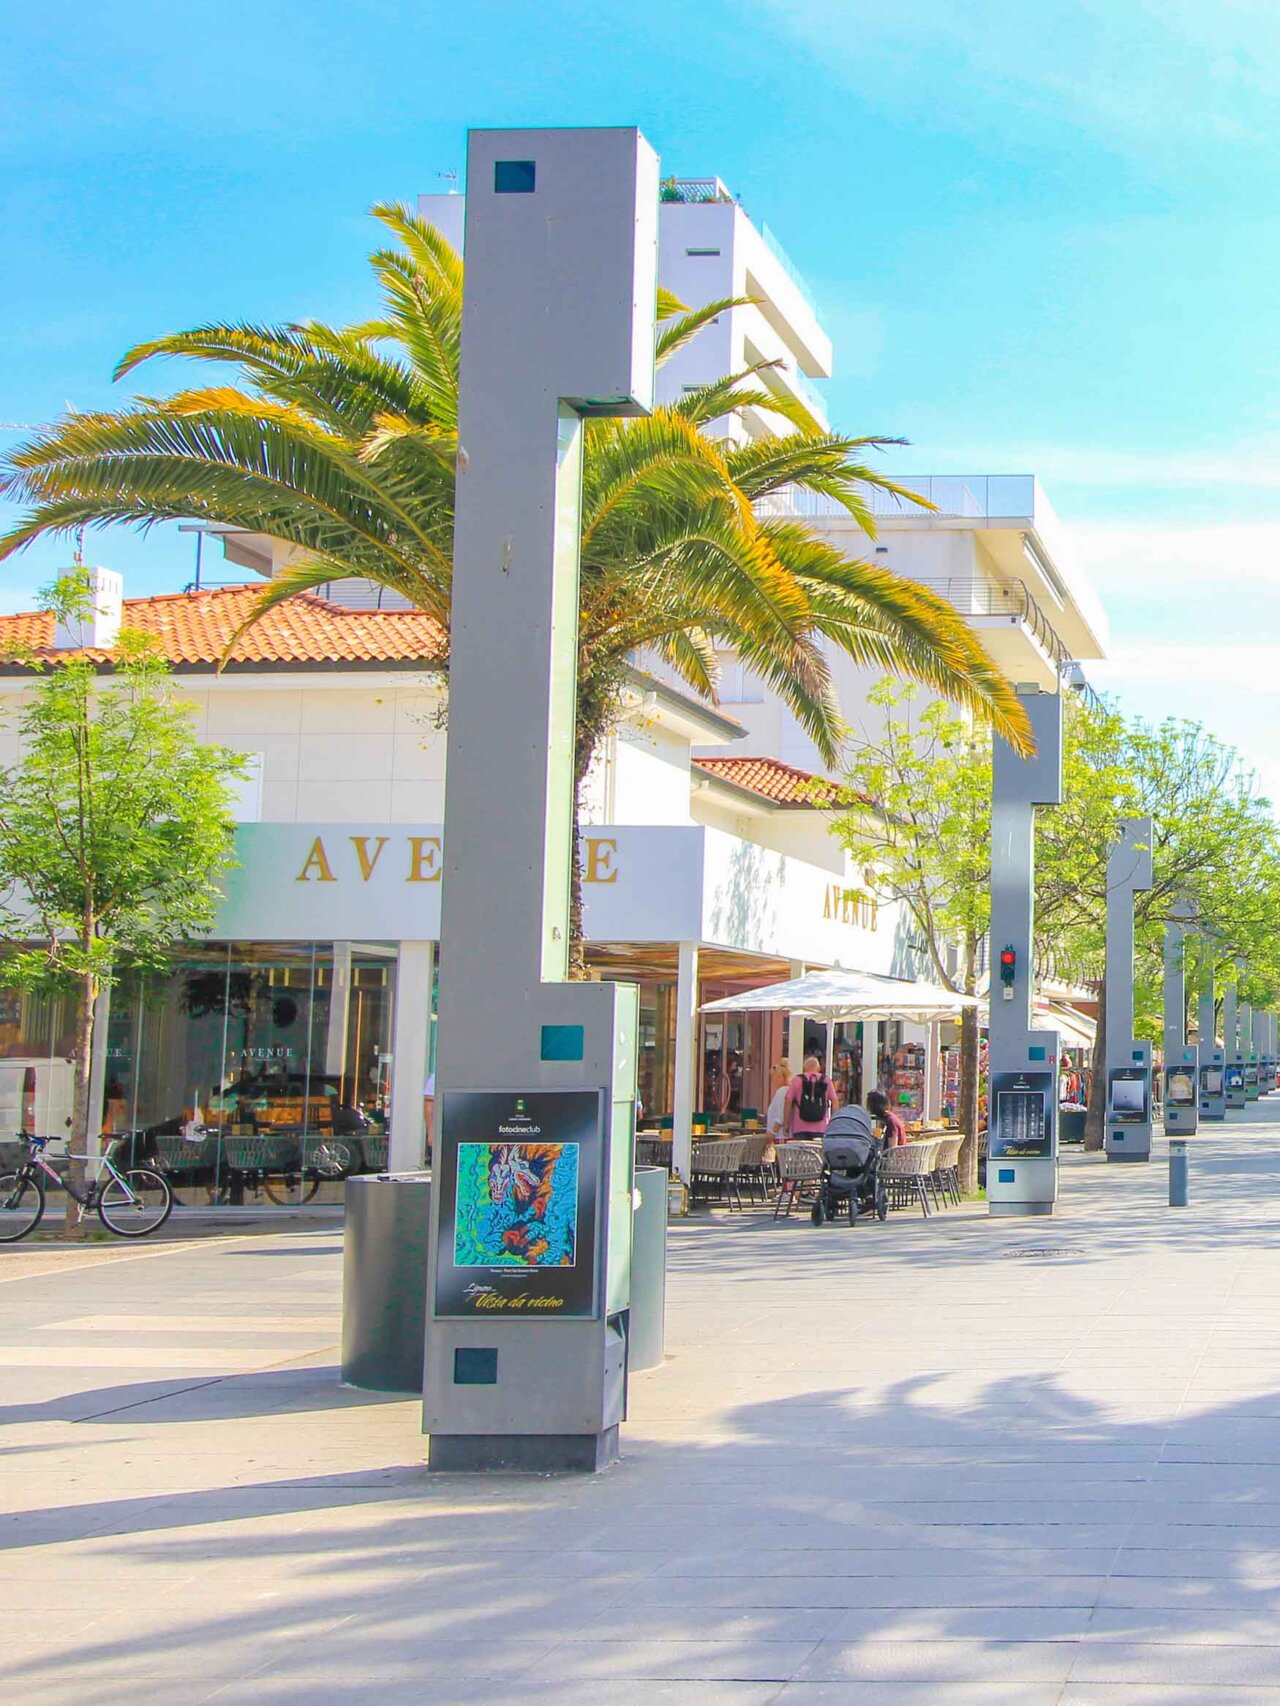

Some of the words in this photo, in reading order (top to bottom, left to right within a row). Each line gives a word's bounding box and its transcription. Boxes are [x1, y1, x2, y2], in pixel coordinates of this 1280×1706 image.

[295, 836, 618, 883] AVEE
[823, 882, 878, 932] AVENUE
[241, 1048, 293, 1057] AVENUE
[498, 1125, 541, 1133] fotocineclub
[527, 1296, 564, 1308] vicino
